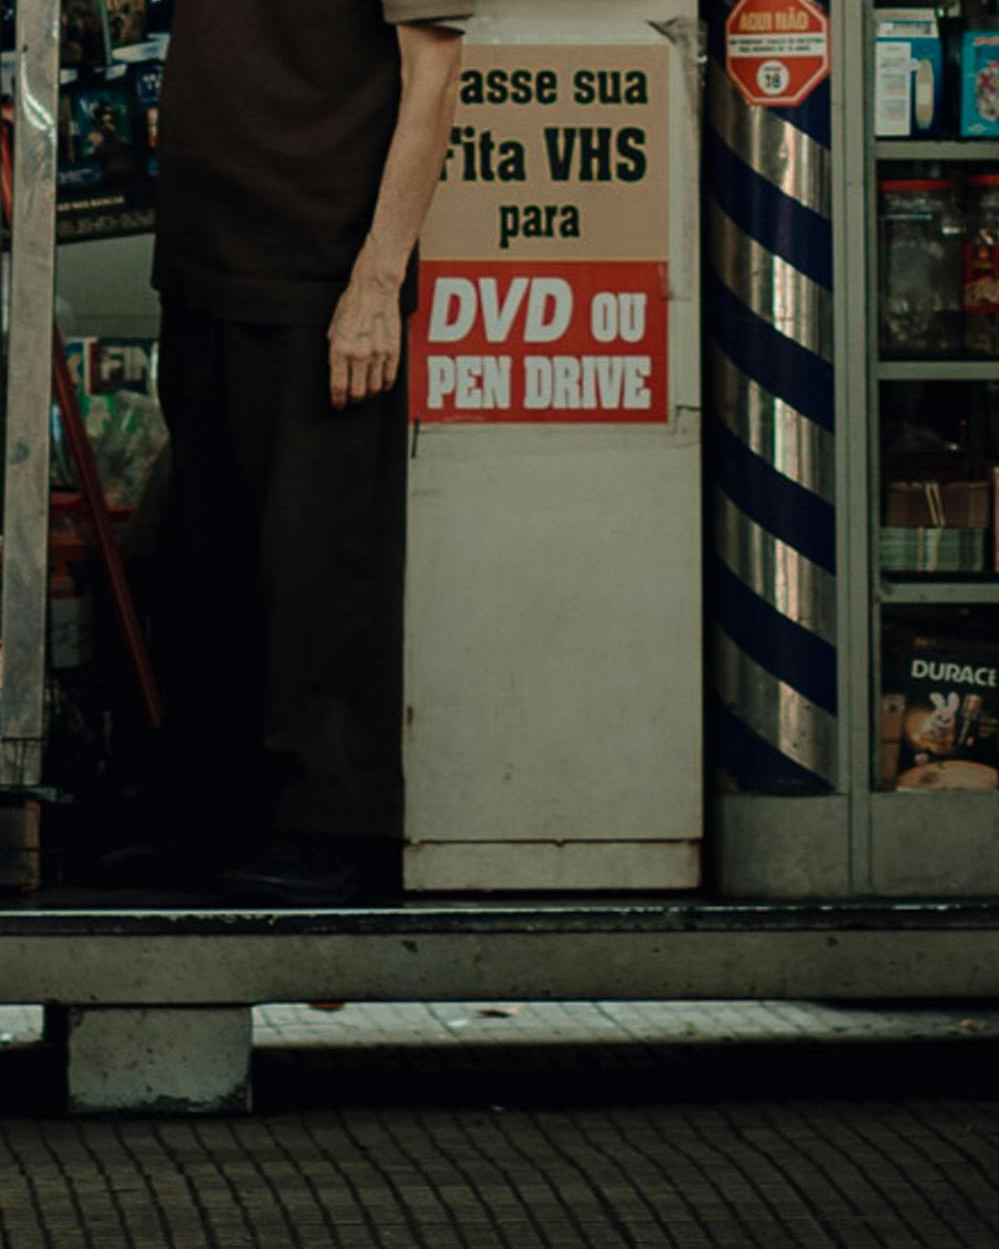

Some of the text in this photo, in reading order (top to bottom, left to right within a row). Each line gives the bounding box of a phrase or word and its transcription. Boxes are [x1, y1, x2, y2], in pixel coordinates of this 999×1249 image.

[739, 7, 810, 31] AQUI NÃO
[574, 68, 648, 106] sua
[545, 127, 648, 182] VHS
[499, 204, 580, 248] para
[427, 277, 648, 344] DVD OU
[426, 354, 652, 410] PEN DRIVE
